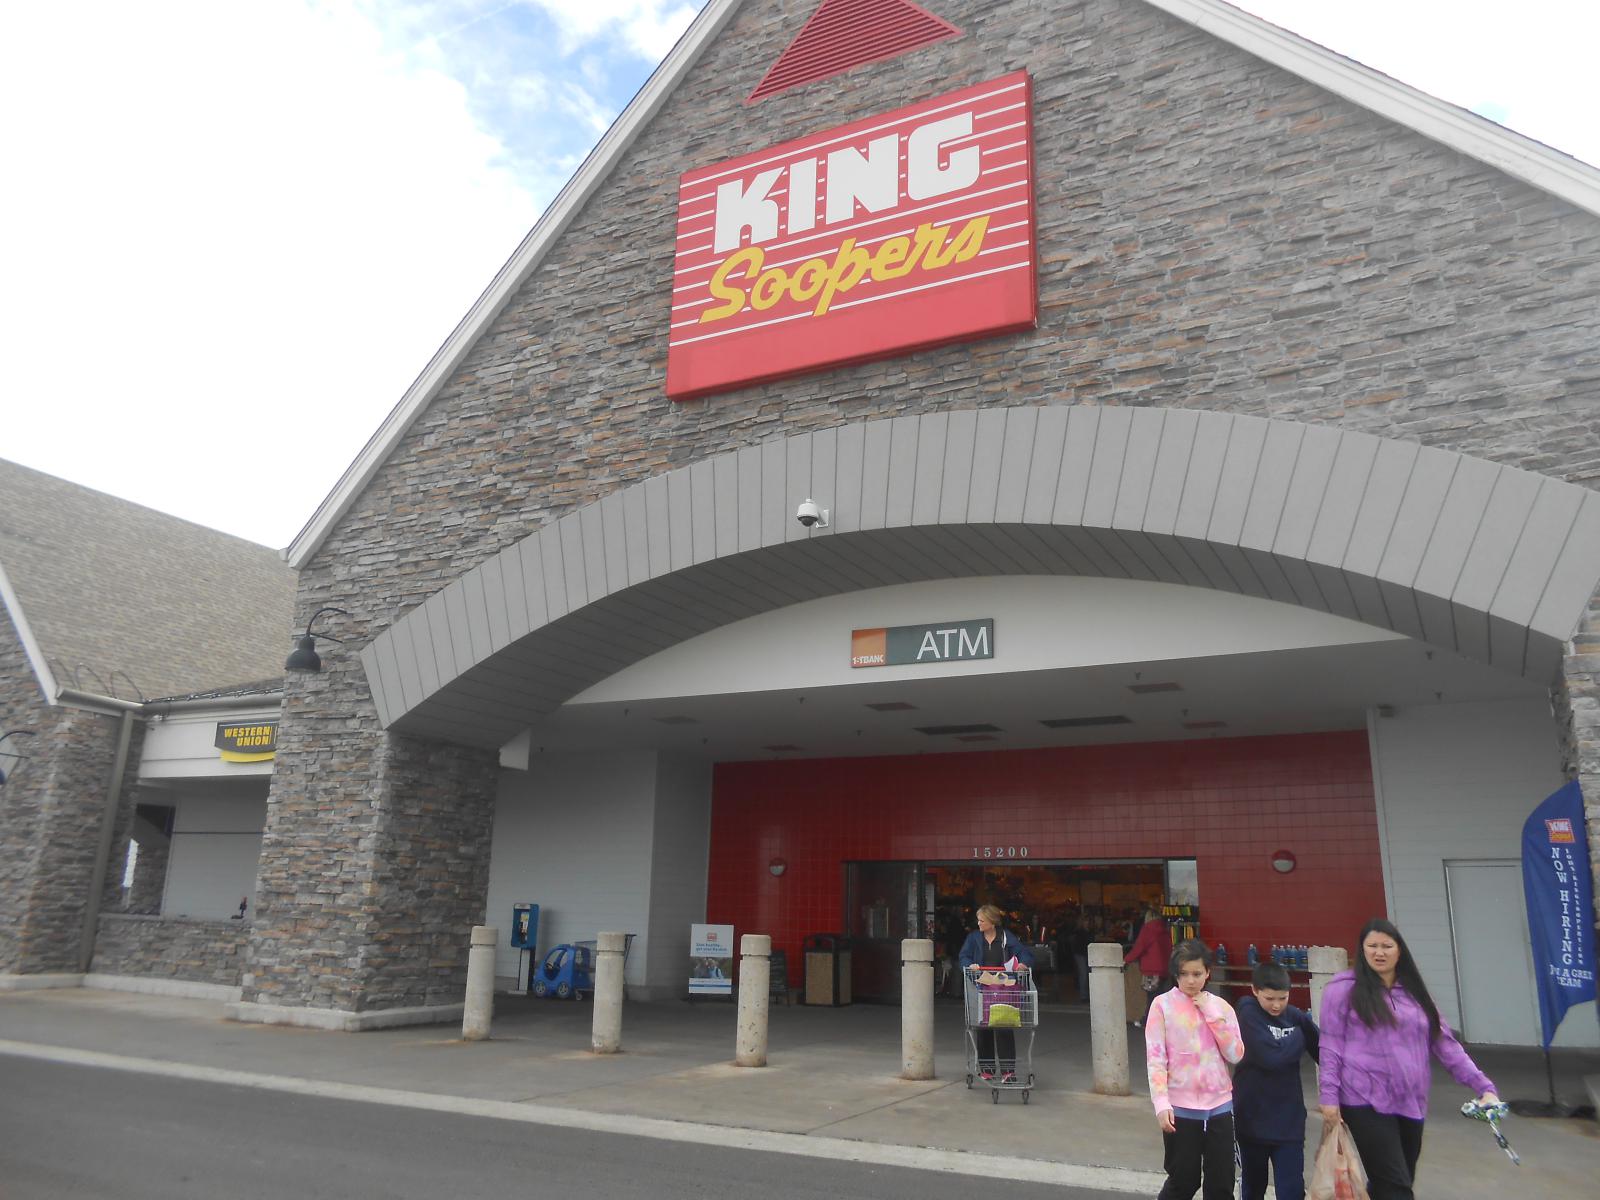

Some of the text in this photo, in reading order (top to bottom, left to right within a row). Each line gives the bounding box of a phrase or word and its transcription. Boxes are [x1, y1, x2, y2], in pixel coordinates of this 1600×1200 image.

[713, 111, 980, 254] KING
[699, 216, 990, 323] Soopers
[916, 626, 989, 660] ATM
[224, 726, 271, 738] WESTERN
[236, 735, 270, 747] UNION
[973, 846, 1028, 858] 15200
[1551, 847, 1568, 883] NOW
[1560, 889, 1573, 965] HIRING
